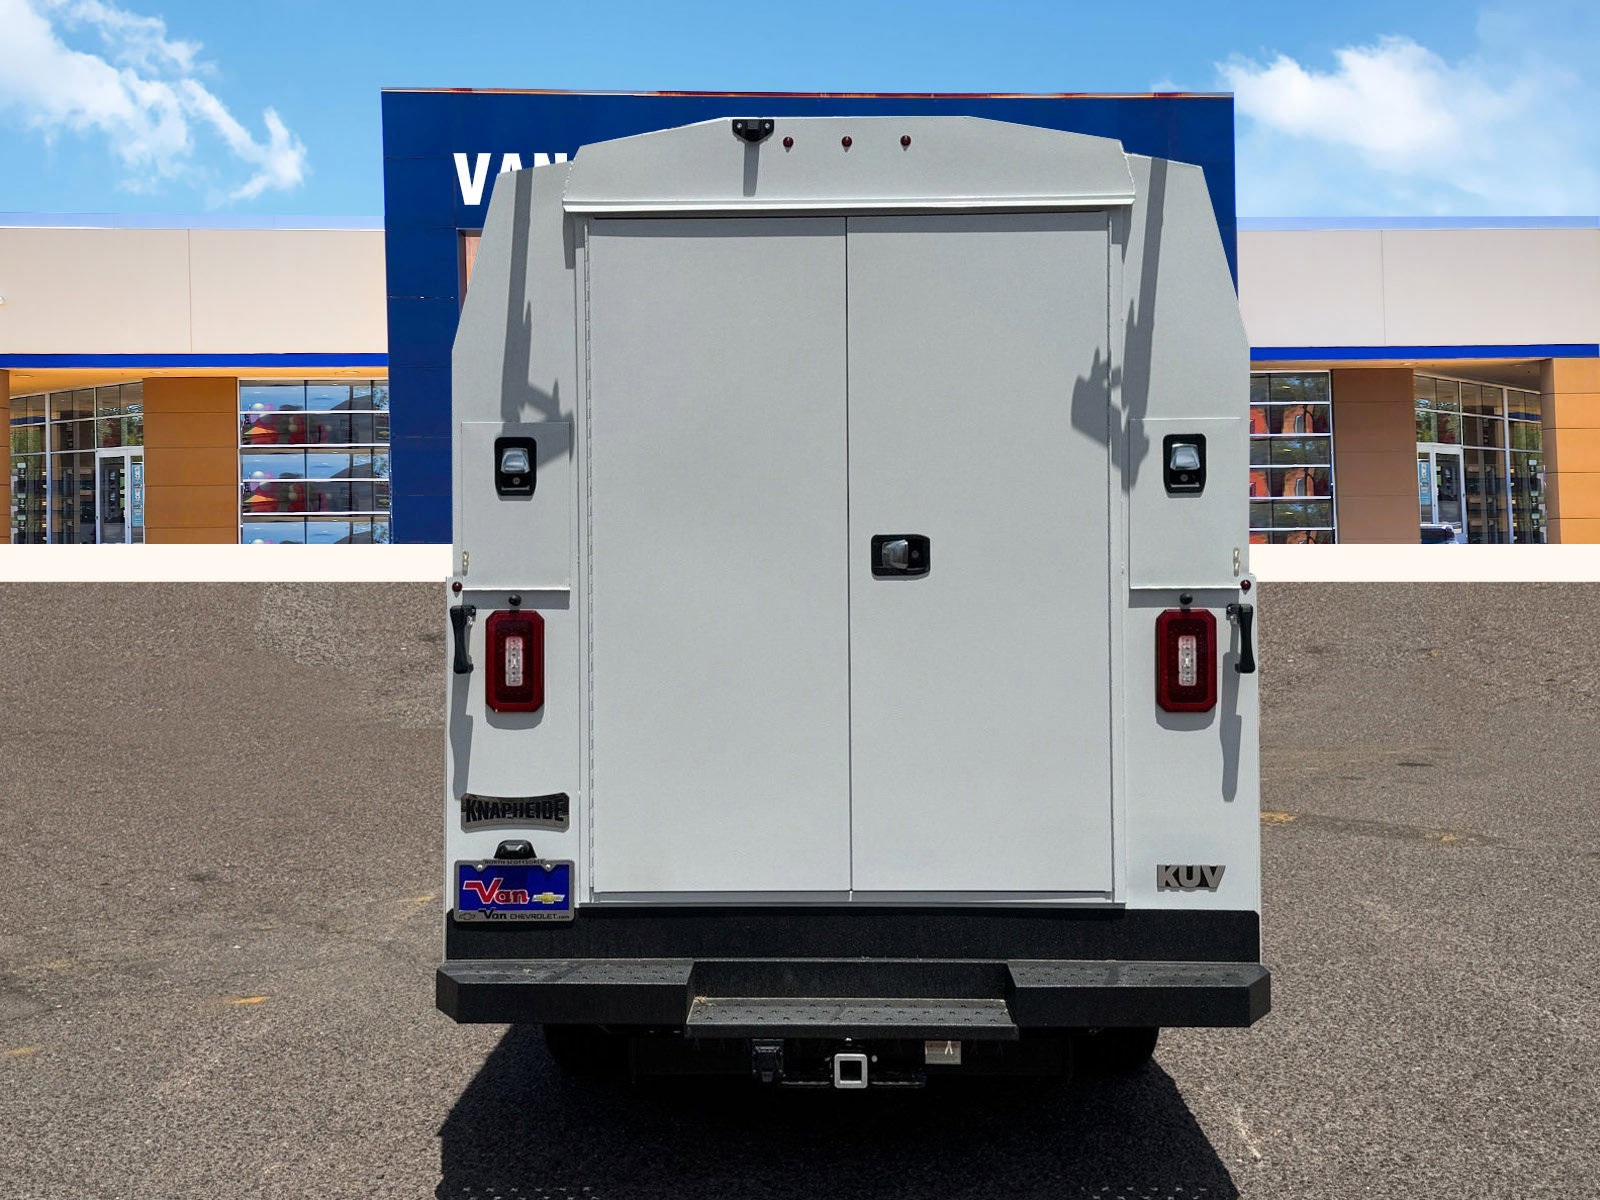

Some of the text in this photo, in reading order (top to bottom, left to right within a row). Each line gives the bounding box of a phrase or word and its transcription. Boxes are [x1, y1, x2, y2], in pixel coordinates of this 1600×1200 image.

[465, 799, 565, 822] KNAPHEIDE
[1157, 864, 1226, 888] KUV
[464, 878, 530, 904] Van
[479, 907, 507, 920] Van
